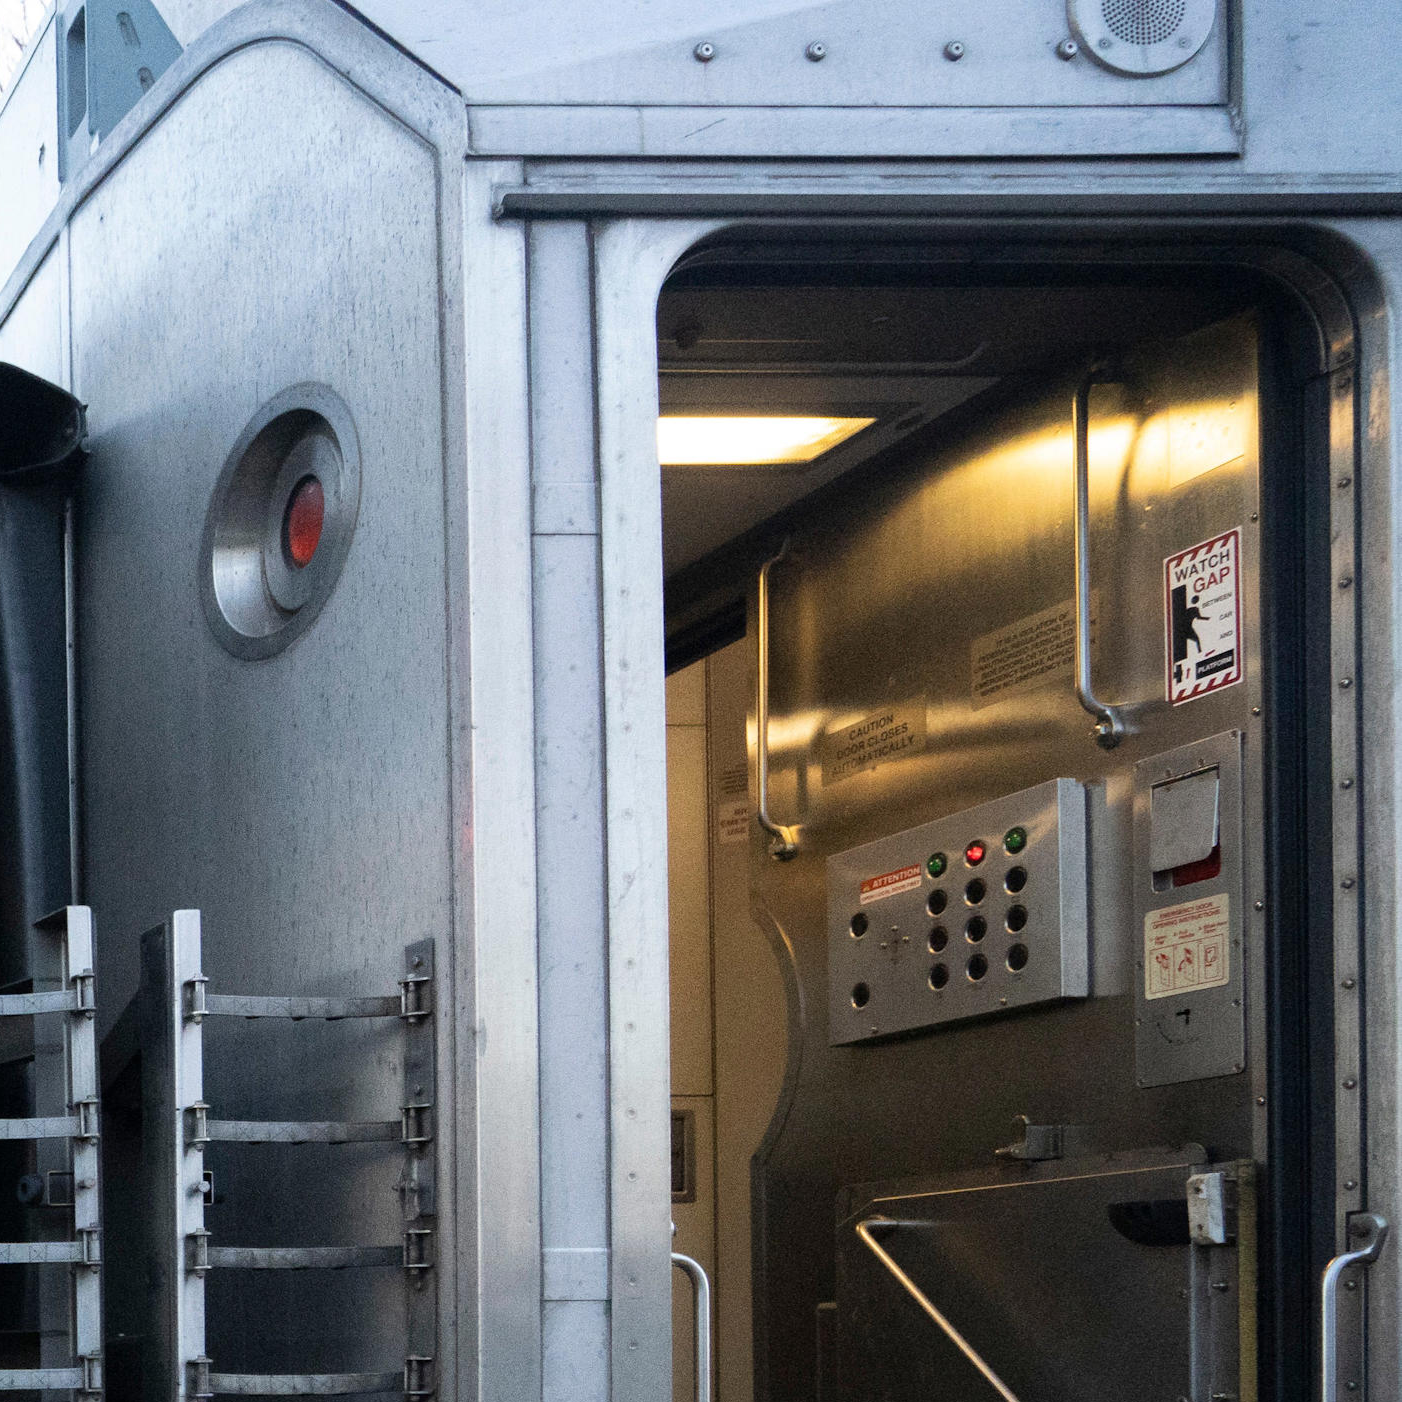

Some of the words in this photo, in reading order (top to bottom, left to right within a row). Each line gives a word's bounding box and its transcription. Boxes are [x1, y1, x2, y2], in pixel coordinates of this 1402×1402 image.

[1175, 549, 1230, 583] WATCH
[1193, 566, 1230, 593] GAP
[1202, 592, 1232, 608] BETWEEN
[1219, 611, 1232, 620] CAR
[1198, 656, 1232, 673] PLATFORM
[849, 714, 894, 740] CAUTION
[837, 740, 865, 760] DOOR
[867, 722, 908, 747] CLOSES
[832, 735, 914, 778] AUTOMATICALLY
[872, 868, 920, 888] ATTENTION
